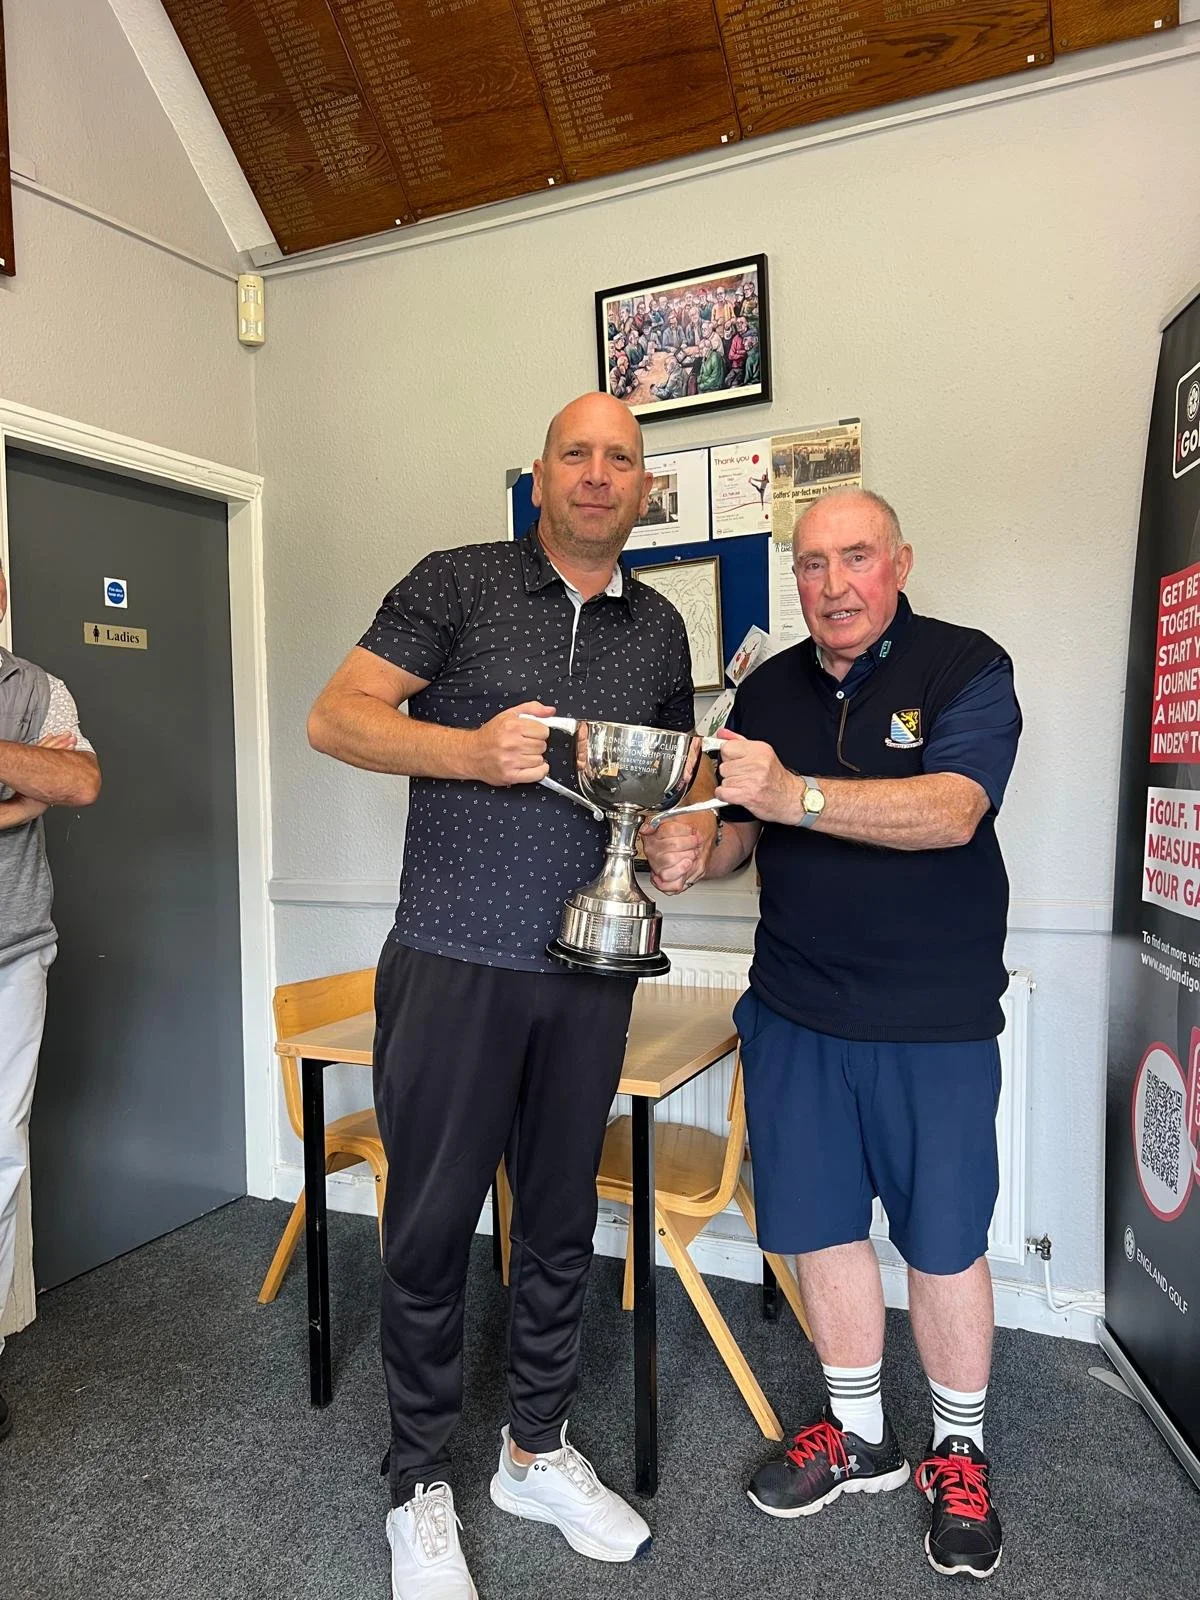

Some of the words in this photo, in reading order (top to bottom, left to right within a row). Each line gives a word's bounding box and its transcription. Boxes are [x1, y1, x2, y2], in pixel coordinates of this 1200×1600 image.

[714, 457, 734, 466] Thank
[736, 455, 750, 464] you
[773, 488, 790, 500] Golfers'
[792, 488, 811, 498] par-fect
[812, 487, 821, 495] way
[1162, 580, 1185, 607] GET
[1186, 573, 1200, 599] BE
[106, 629, 140, 643] Ladies
[1158, 638, 1192, 667] START
[1154, 704, 1165, 725] A
[1149, 797, 1187, 829] iGOLF.
[1145, 867, 1178, 901] YOUR
[1142, 930, 1151, 944] To
[1151, 934, 1161, 950] find
[1161, 942, 1170, 955] out
[1170, 947, 1187, 963] more
[1136, 1248, 1167, 1294] ENGLAND
[1168, 1284, 1188, 1315] GOLF
